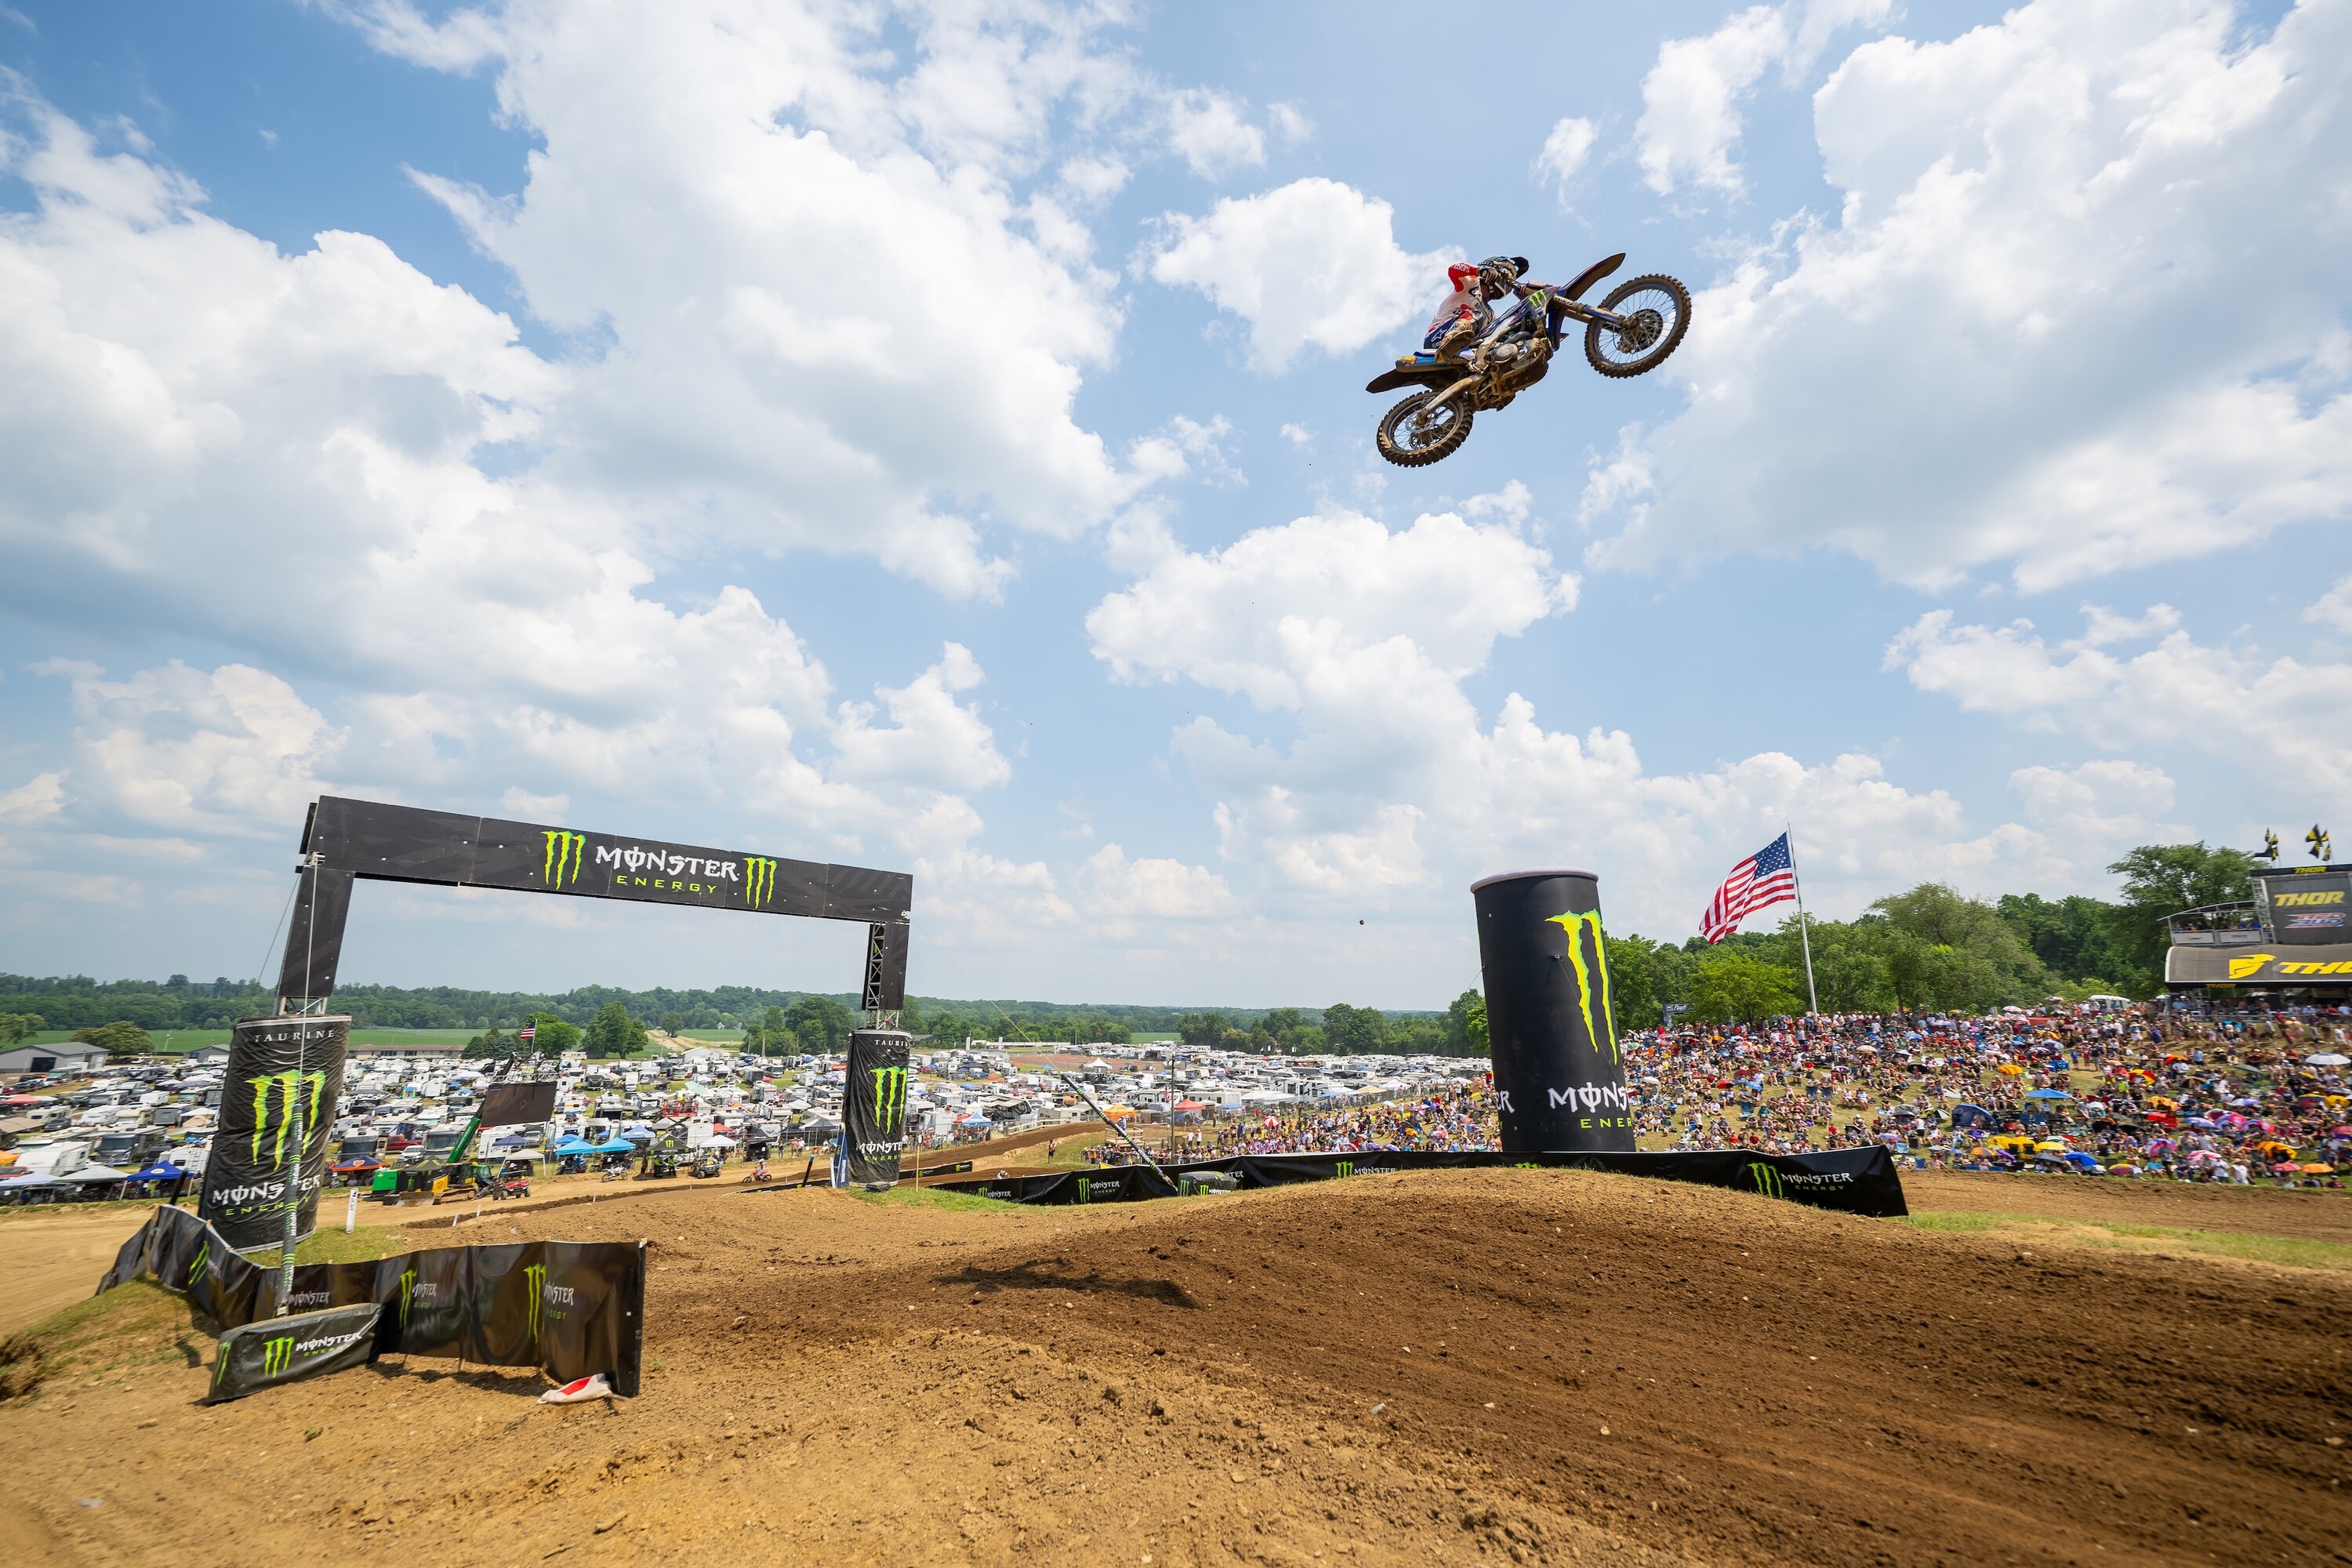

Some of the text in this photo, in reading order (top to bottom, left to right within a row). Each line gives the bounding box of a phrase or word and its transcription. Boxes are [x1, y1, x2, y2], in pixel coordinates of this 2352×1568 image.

[595, 845, 739, 882] MONSTER
[616, 875, 717, 894] ENERGY
[2274, 891, 2346, 906] THOR
[254, 1029, 335, 1043] TAURINE
[1090, 1181, 1120, 1190] MONSTER
[1780, 1172, 1854, 1185] MONSTER
[212, 1174, 321, 1206] MONSER
[225, 1196, 311, 1216] ENERY
[296, 1333, 362, 1352] MONSTER
